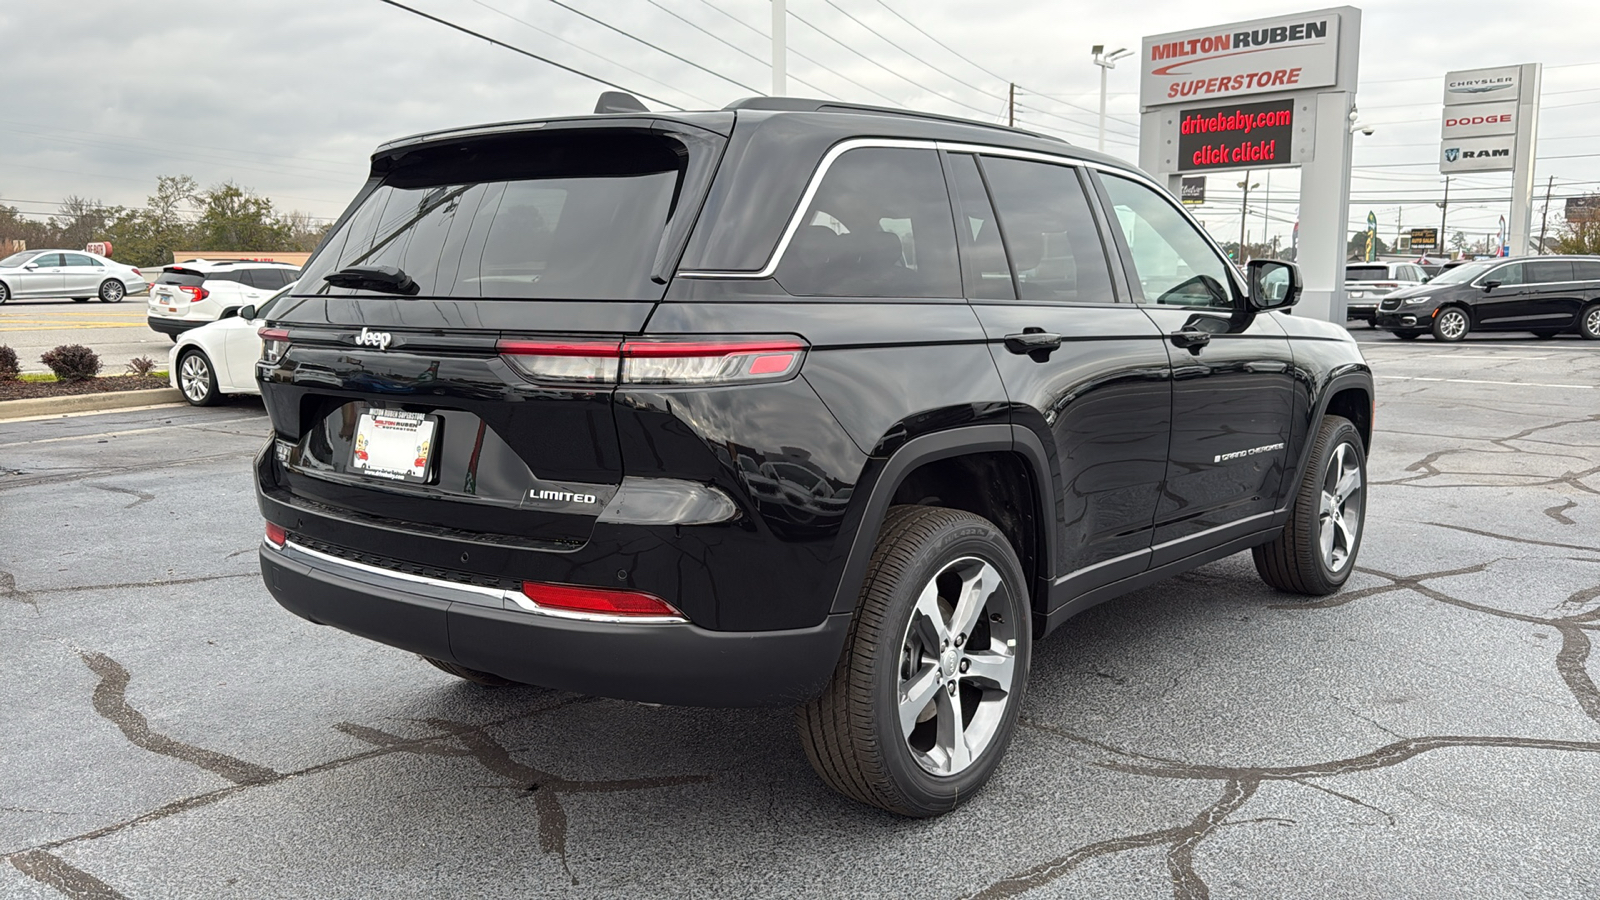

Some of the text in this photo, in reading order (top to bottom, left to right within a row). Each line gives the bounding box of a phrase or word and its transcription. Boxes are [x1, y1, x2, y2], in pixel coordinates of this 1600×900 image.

[1151, 20, 1327, 61] MILTON RUBEN
[1167, 67, 1303, 98] SUPERSTORE
[1449, 77, 1513, 88] CHRYSLER
[1181, 110, 1291, 134] drivebaby.com
[1445, 114, 1512, 127] DODGE
[1193, 139, 1275, 165] click click!
[1462, 148, 1509, 159] RAM
[355, 327, 391, 350] Jeep
[369, 408, 425, 420] MILTON RUBEN SUPERSTORE
[1221, 442, 1285, 461] GRAND CHEROKEE
[529, 489, 596, 504] LIMITED
